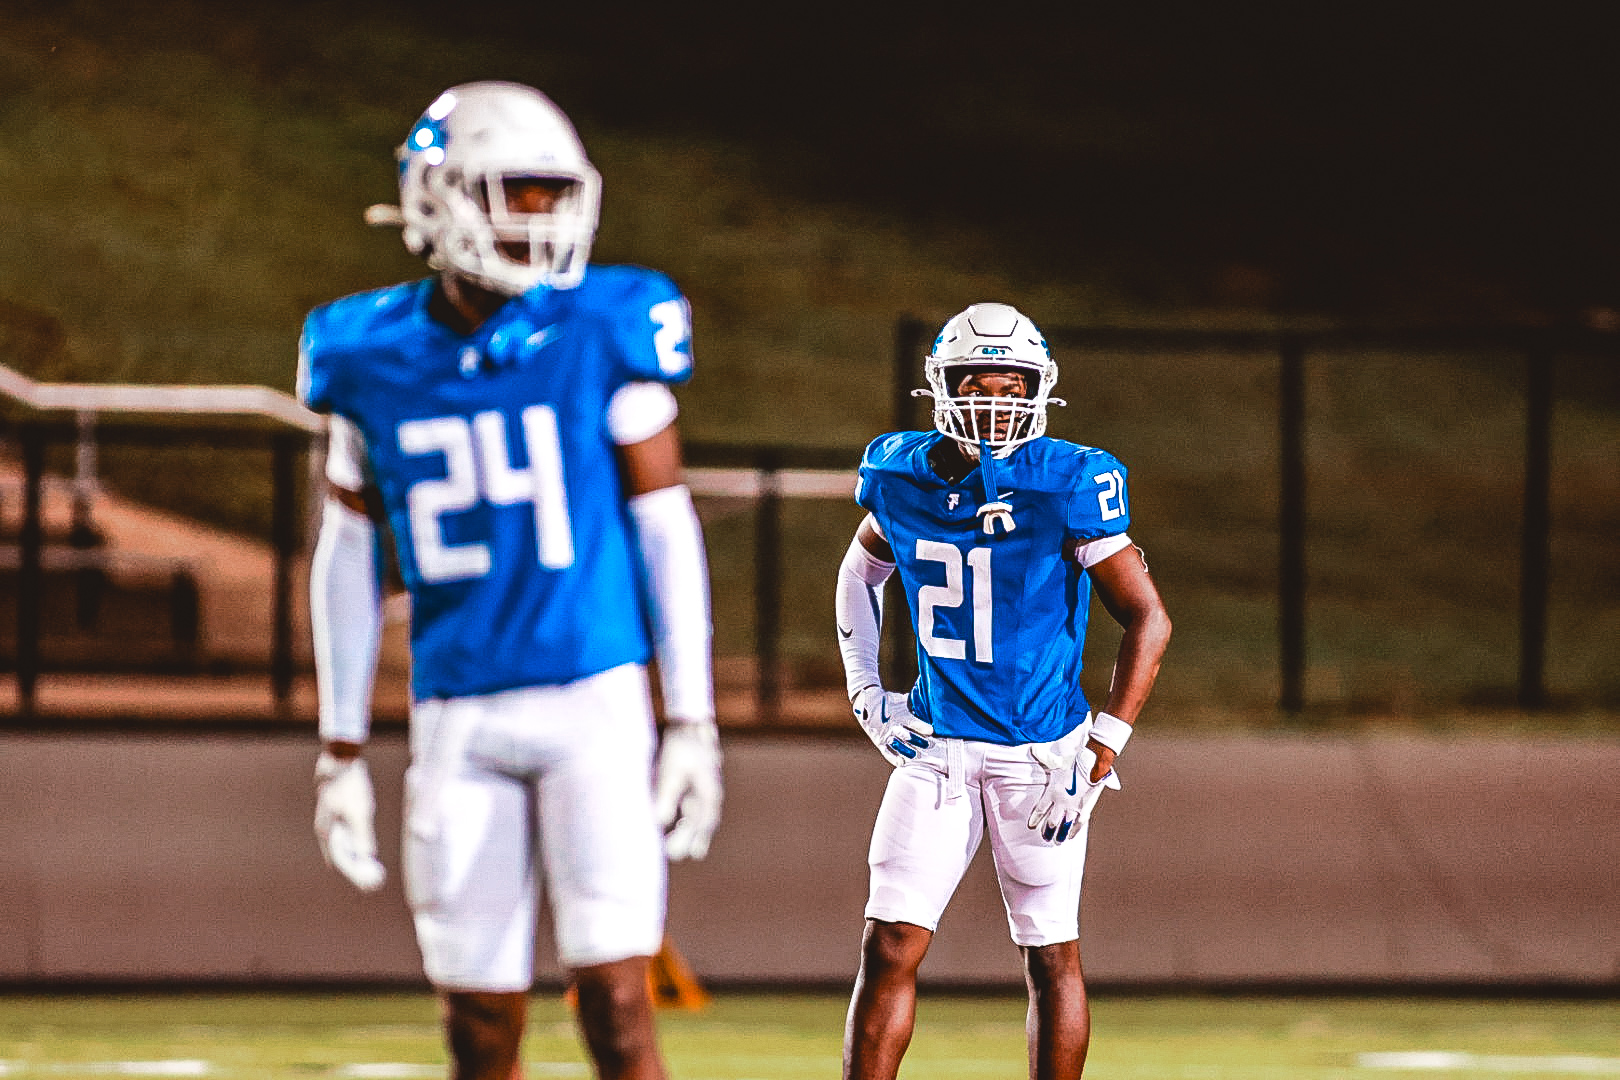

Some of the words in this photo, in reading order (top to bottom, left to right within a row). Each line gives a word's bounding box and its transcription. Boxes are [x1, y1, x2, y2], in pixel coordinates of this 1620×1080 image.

[398, 405, 573, 582] 24
[1094, 469, 1125, 521] 21
[916, 538, 993, 663] 21
